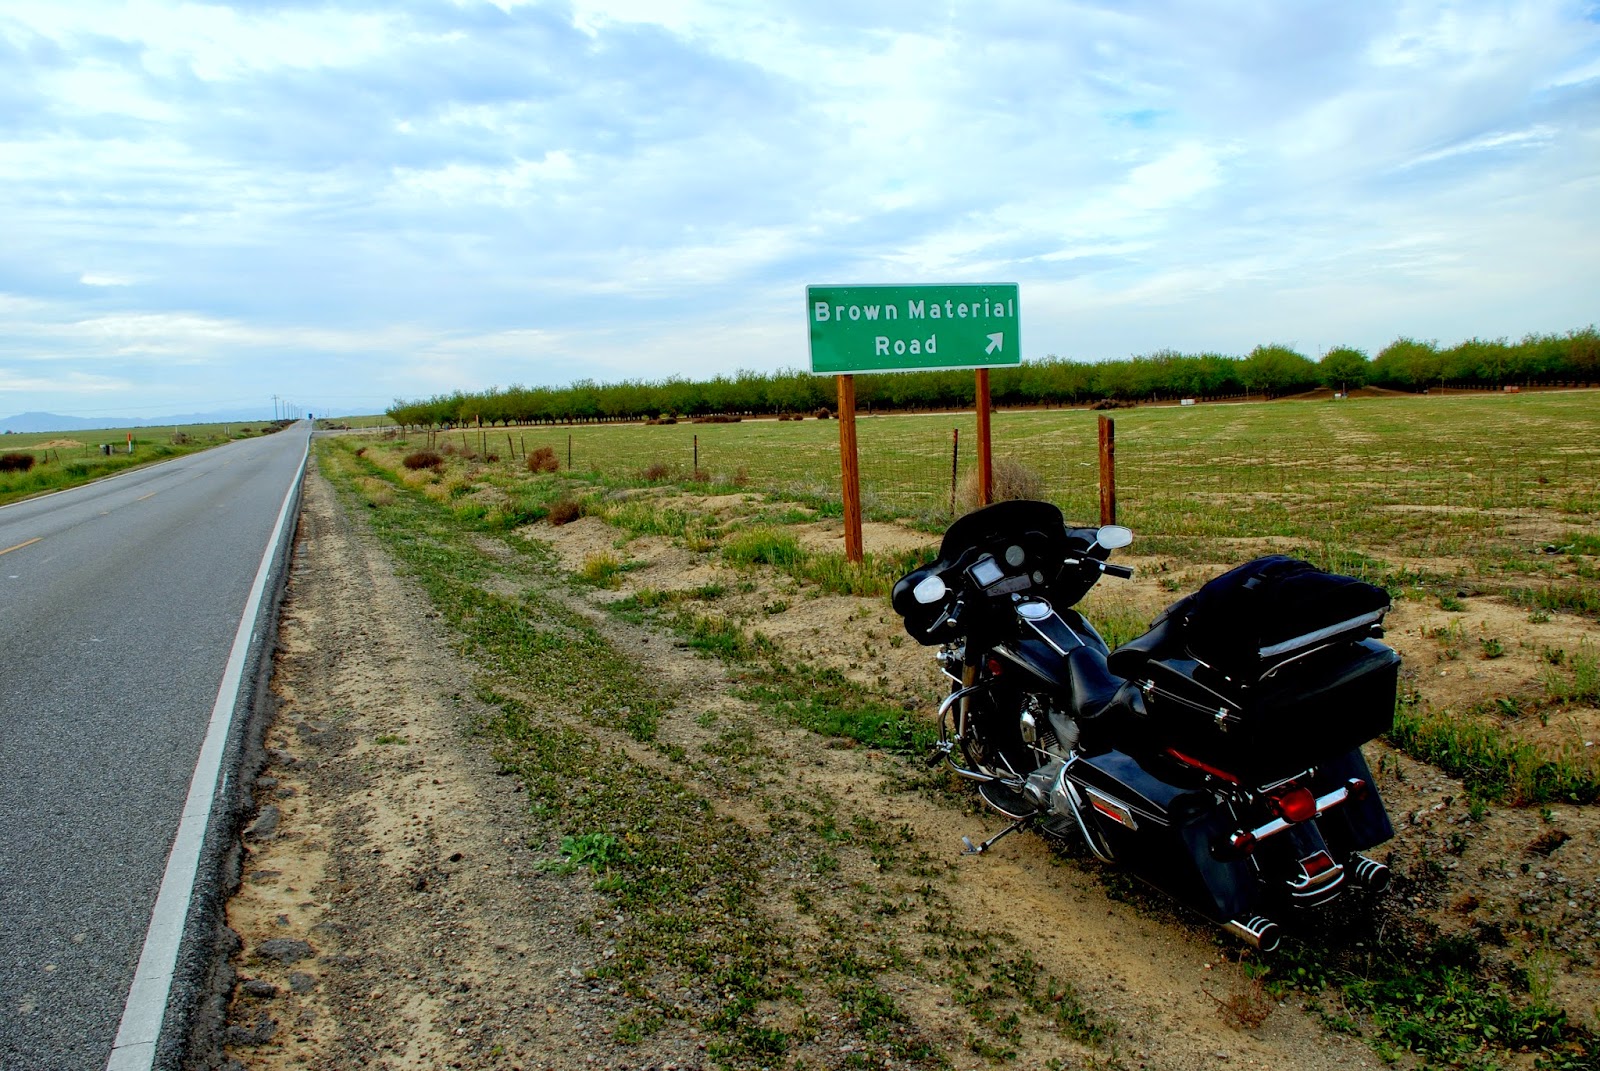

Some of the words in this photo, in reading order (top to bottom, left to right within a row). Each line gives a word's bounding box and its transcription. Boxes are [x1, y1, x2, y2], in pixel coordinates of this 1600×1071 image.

[814, 301, 898, 322] Brown
[908, 298, 1014, 320] Material
[875, 334, 937, 356] Road
